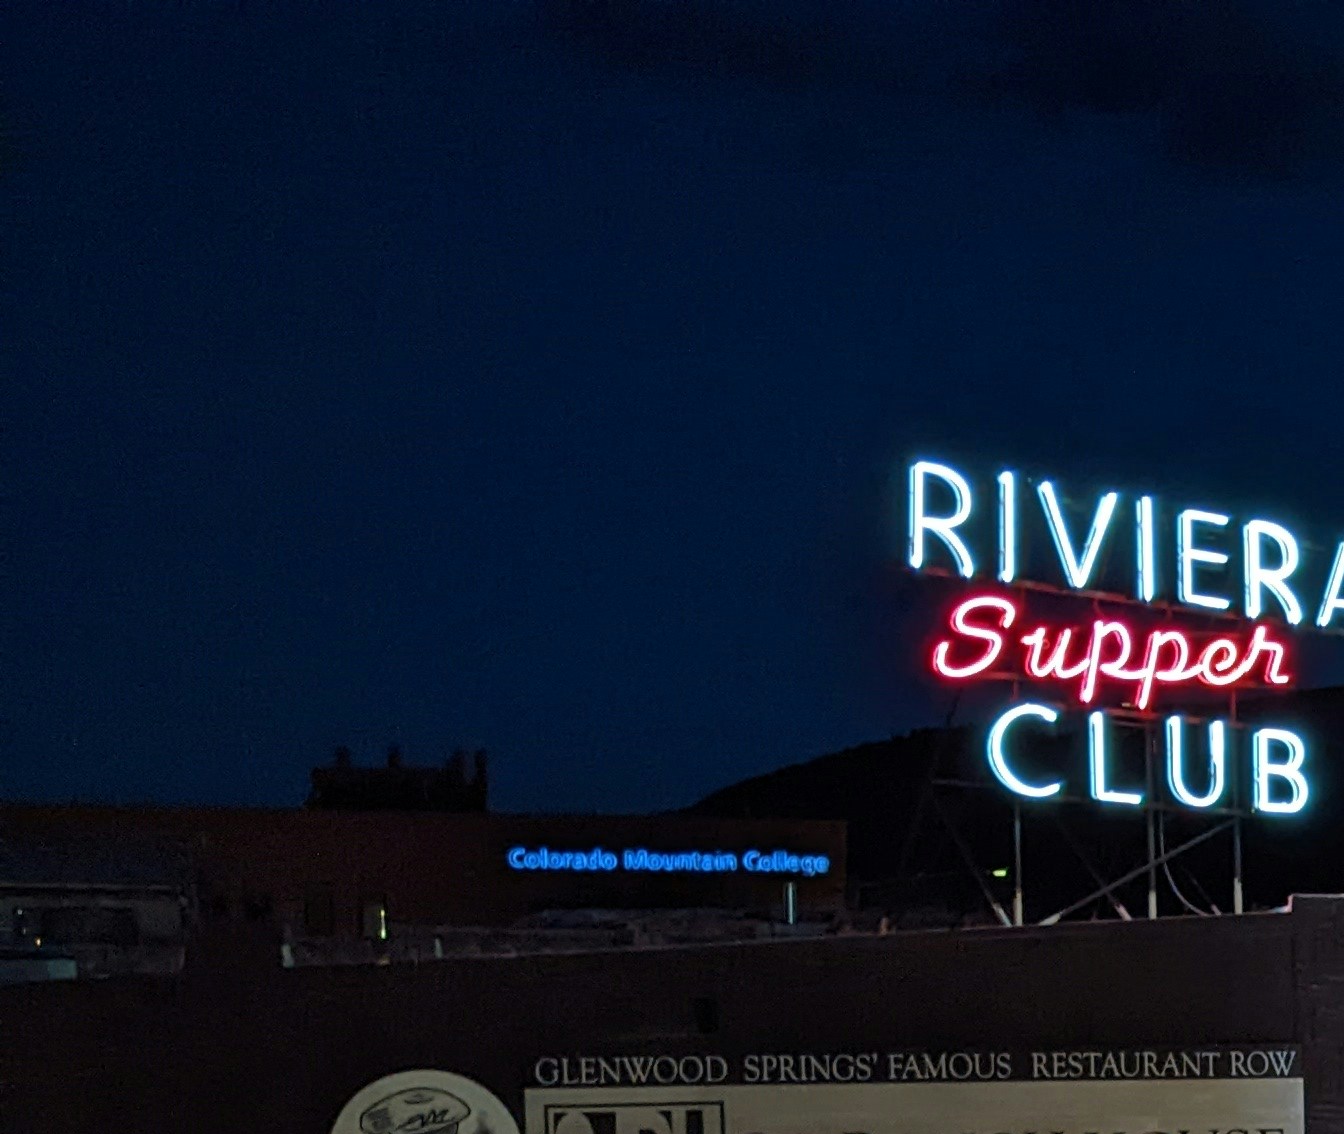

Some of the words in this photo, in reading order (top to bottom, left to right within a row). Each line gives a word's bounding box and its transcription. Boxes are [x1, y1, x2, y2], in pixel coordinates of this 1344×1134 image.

[932, 597, 1290, 710] Supper
[986, 703, 1310, 813] CLUB
[508, 848, 617, 870] Colorado
[624, 850, 736, 871] Mountain
[743, 850, 829, 876] College
[534, 1055, 728, 1084] GLENWOOD
[744, 1053, 877, 1082] SPRINGS'
[888, 1052, 1011, 1081] FAMOUS
[1032, 1051, 1220, 1078] RESTAURANT
[1230, 1050, 1296, 1077] ROW
